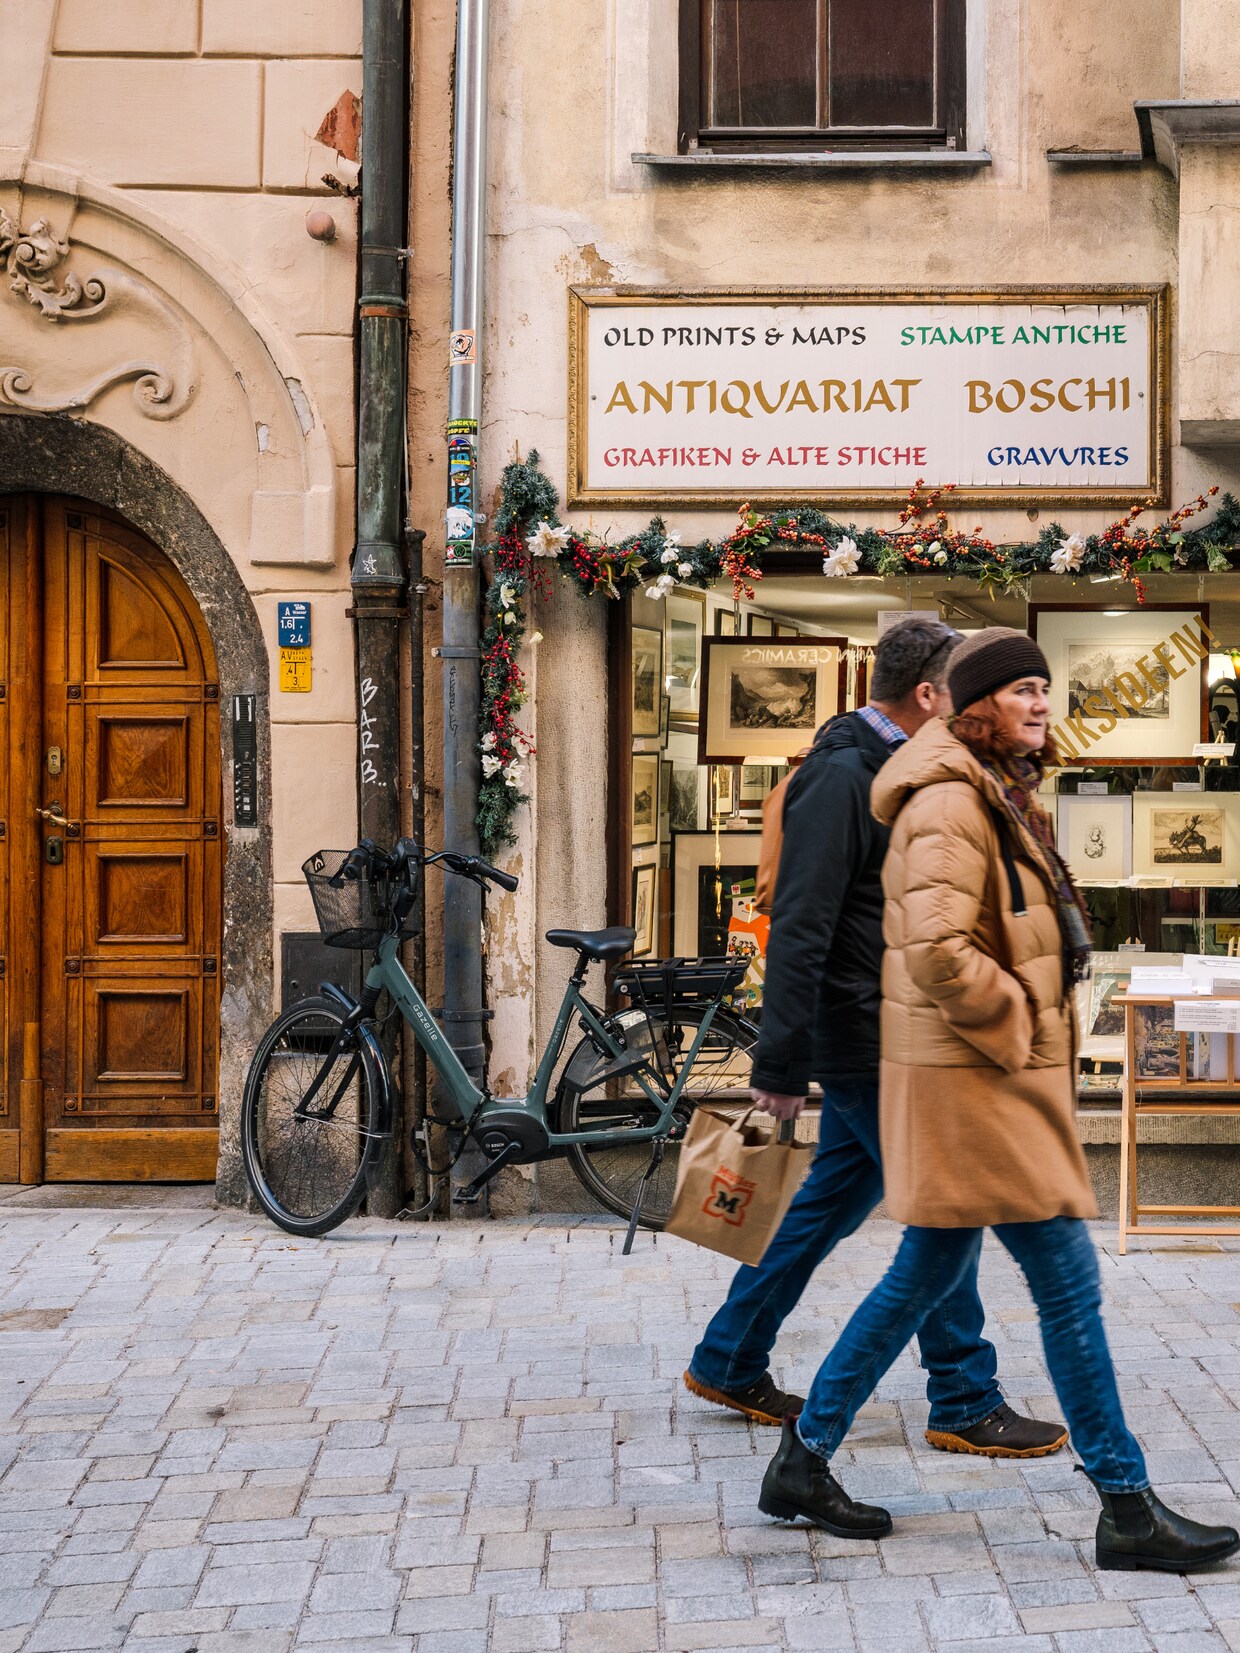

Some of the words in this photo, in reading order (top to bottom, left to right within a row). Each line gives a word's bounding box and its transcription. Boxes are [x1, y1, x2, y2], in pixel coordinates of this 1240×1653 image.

[604, 328, 654, 346] OLD
[662, 327, 755, 346] PRINTS
[765, 328, 784, 346] &
[793, 327, 866, 346] MAPS
[901, 326, 1005, 346] STAMPE
[1012, 325, 1127, 345] ANTICHE
[605, 379, 922, 418] ANTIQUARIAT
[964, 377, 1130, 414] BOSCHI
[604, 448, 731, 467] GRAFIKEN
[742, 448, 761, 467] &
[767, 447, 829, 466] ALTE
[838, 447, 927, 466] STICHE
[988, 447, 1129, 467] GRAVURES
[1042, 614, 1221, 780] NKSIDEEN!
[412, 1003, 438, 1042] Gazelle
[552, 1018, 564, 1044] Gazelle
